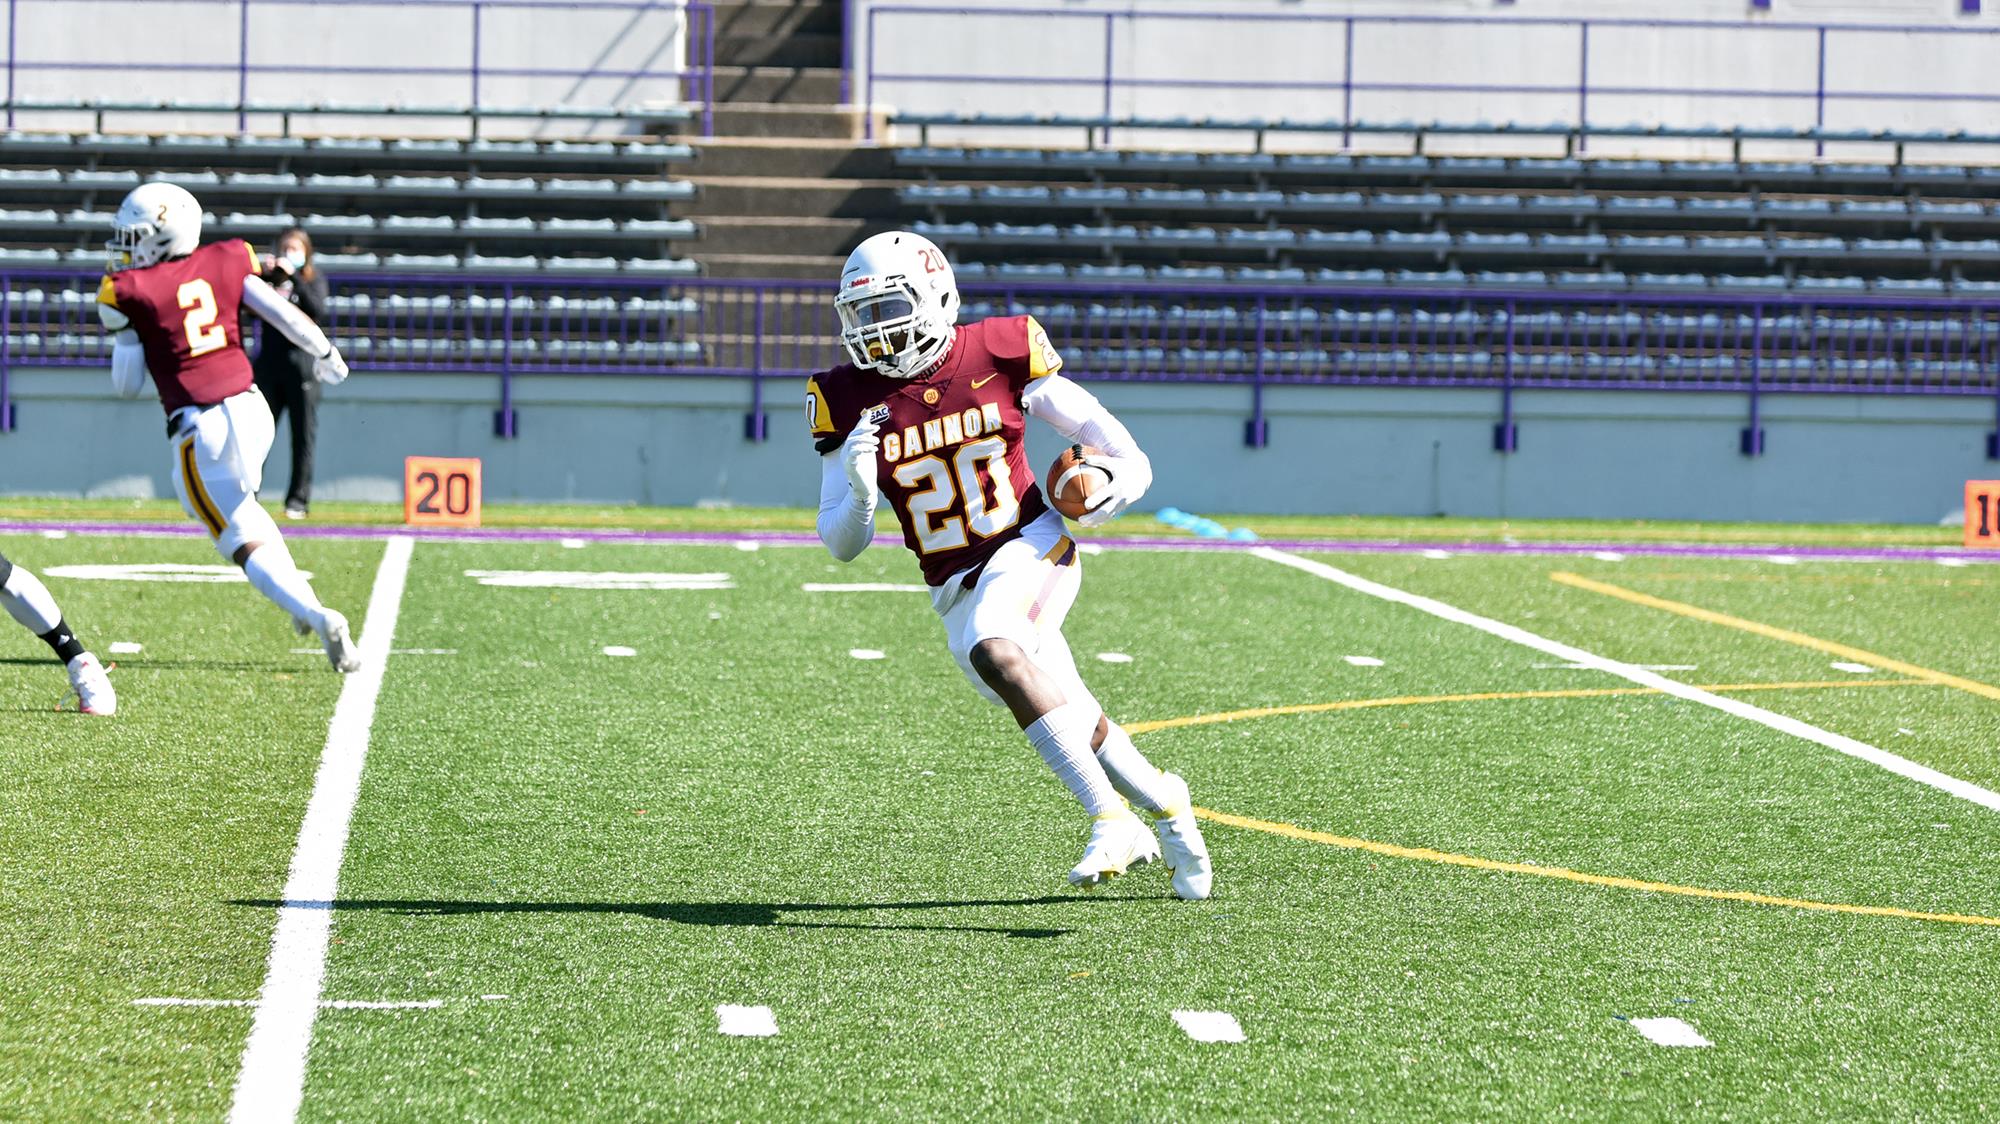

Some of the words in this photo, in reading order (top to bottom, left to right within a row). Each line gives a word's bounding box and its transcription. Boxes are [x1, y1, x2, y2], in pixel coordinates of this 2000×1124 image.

[918, 248, 945, 274] 20
[177, 278, 228, 357] 2
[883, 402, 1002, 462] GANNON
[417, 472, 469, 514] 20
[892, 435, 1021, 555] 20
[1978, 495, 2000, 536] 1
